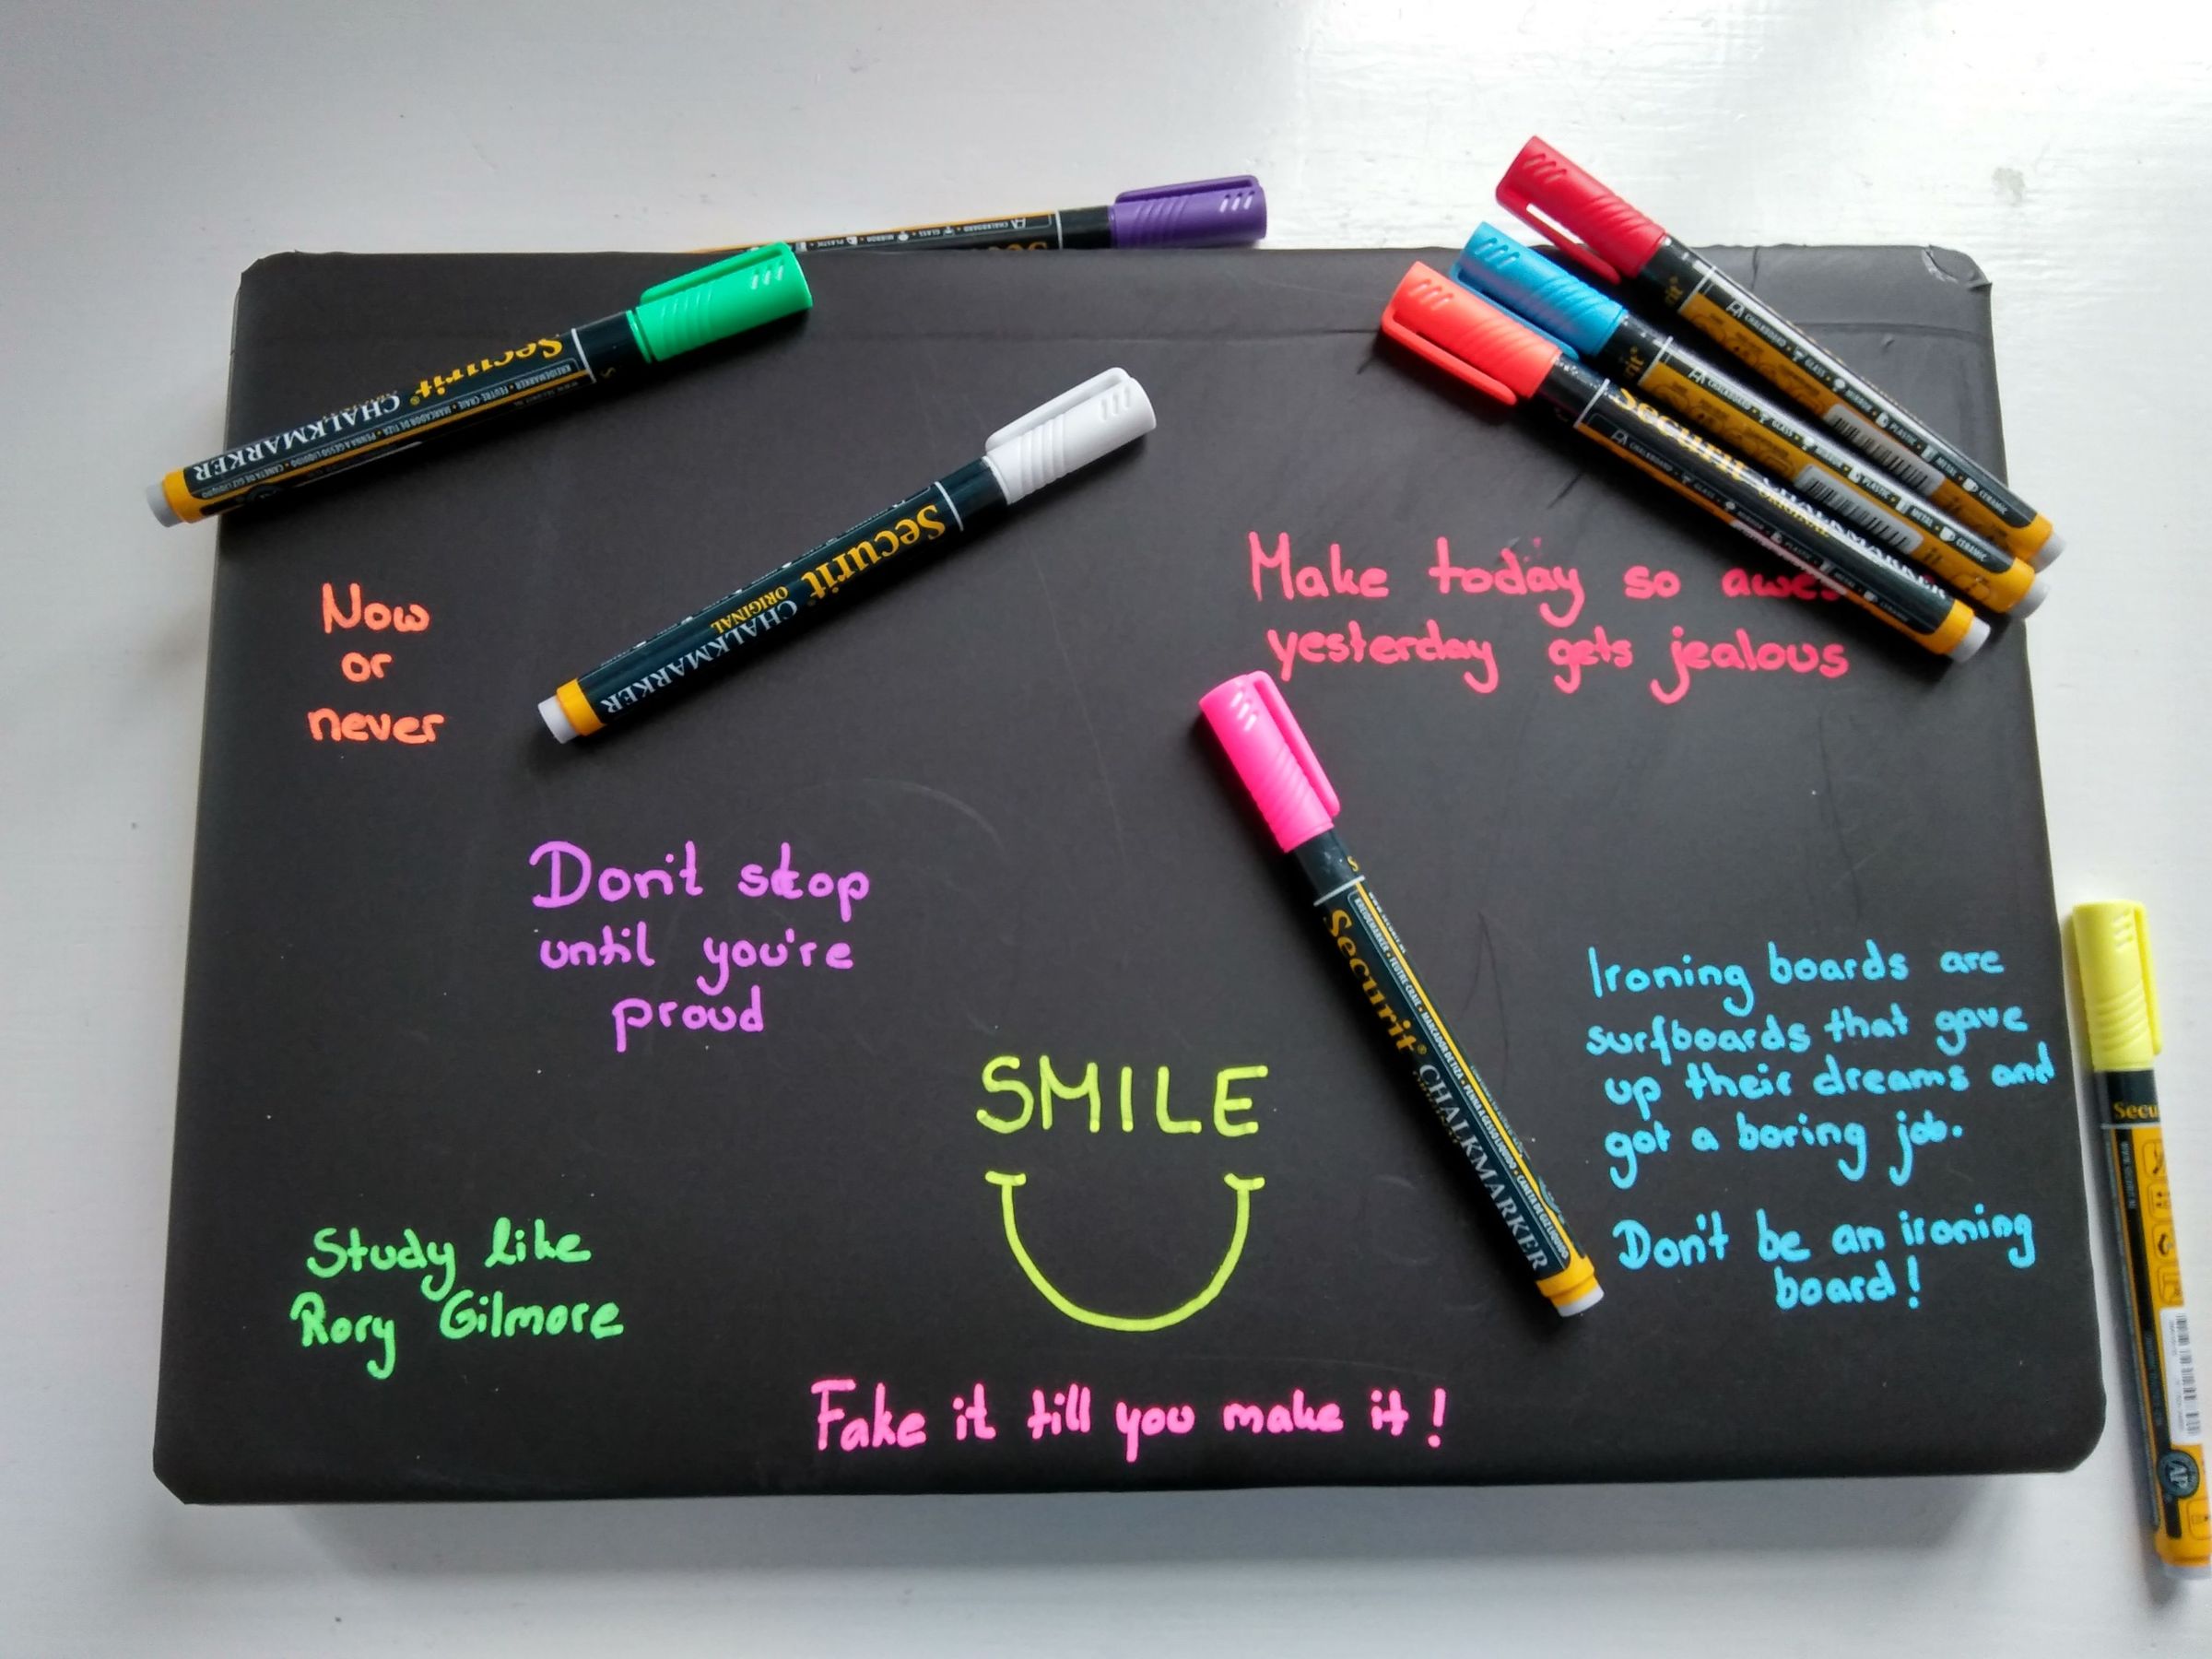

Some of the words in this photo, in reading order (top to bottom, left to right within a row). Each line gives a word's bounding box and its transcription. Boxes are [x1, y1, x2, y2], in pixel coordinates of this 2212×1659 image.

[514, 363, 571, 390] KREIDEMARKER
[1743, 312, 1787, 347] CHALKBOARD
[1803, 357, 1826, 378] GLASS
[1888, 421, 1917, 446] PLASTIC
[1935, 456, 1958, 477] METAL
[1977, 488, 2008, 515] CERAMIC
[193, 395, 401, 481] CHALKMARKER
[1706, 378, 1751, 410] CHALKBOARD
[1771, 418, 1794, 437] GLASS
[1861, 476, 1890, 500] PLASTIC
[1910, 507, 1934, 526] METAL
[1955, 536, 1987, 562] CERAMIC
[322, 582, 430, 634] Now
[710, 584, 789, 635] ORIGINAL
[1247, 531, 1390, 601] Make
[1427, 536, 1586, 629] today
[1620, 564, 1682, 601] so
[341, 651, 393, 683] or
[601, 600, 798, 713] CHALKMARKER
[1265, 618, 1500, 695] yesterday
[1547, 625, 1633, 694] gets
[1648, 626, 1850, 705] jealous
[307, 707, 445, 745] never
[529, 840, 704, 908] Don't
[736, 841, 870, 923] stop
[539, 921, 655, 970] until
[696, 928, 854, 996] you're
[1587, 945, 1757, 1018] Ironing
[1768, 939, 1910, 985] boards
[1939, 949, 2006, 975] are
[611, 983, 764, 1053] proud
[1353, 896, 1391, 953] KREIDEMARKER
[1387, 956, 1421, 1007] FEUTRE-CRAIE
[1419, 1011, 1448, 1053] MARCADOR
[1449, 1060, 1465, 1079] TIZA
[1462, 1083, 1483, 1112] PENNA
[1479, 1113, 1500, 1140] GESSO
[1493, 1136, 1518, 1171] LIQUIDO
[1514, 1173, 1538, 1206] CANETA
[1585, 1014, 1812, 1066] surfboards
[1823, 1003, 1910, 1044] that
[1935, 1005, 2030, 1057] gave
[976, 1053, 1269, 1136] SMILE
[1604, 1076, 1662, 1121] up
[1685, 1061, 1793, 1101] their
[1812, 1053, 1971, 1097] dreams
[1991, 1041, 2055, 1088] and
[1420, 1065, 1547, 1270] CHALKMARKER
[1604, 1119, 1672, 1190] got
[1690, 1127, 1722, 1153] a
[1736, 1112, 1868, 1182] boring
[1888, 1109, 1964, 1186] job.
[307, 1228, 455, 1301] Study
[485, 1217, 592, 1268] like
[1611, 1210, 1729, 1271] Don't
[1756, 1208, 1811, 1263] be
[1830, 1223, 1887, 1255] an
[1899, 1202, 2036, 1269] ironing
[288, 1291, 395, 1379] Rory
[440, 1288, 624, 1339] Gilmore
[811, 1377, 926, 1453] Fake
[952, 1382, 996, 1441] it
[1027, 1382, 1091, 1440] till
[1114, 1400, 1195, 1463] you
[1221, 1387, 1344, 1435] make
